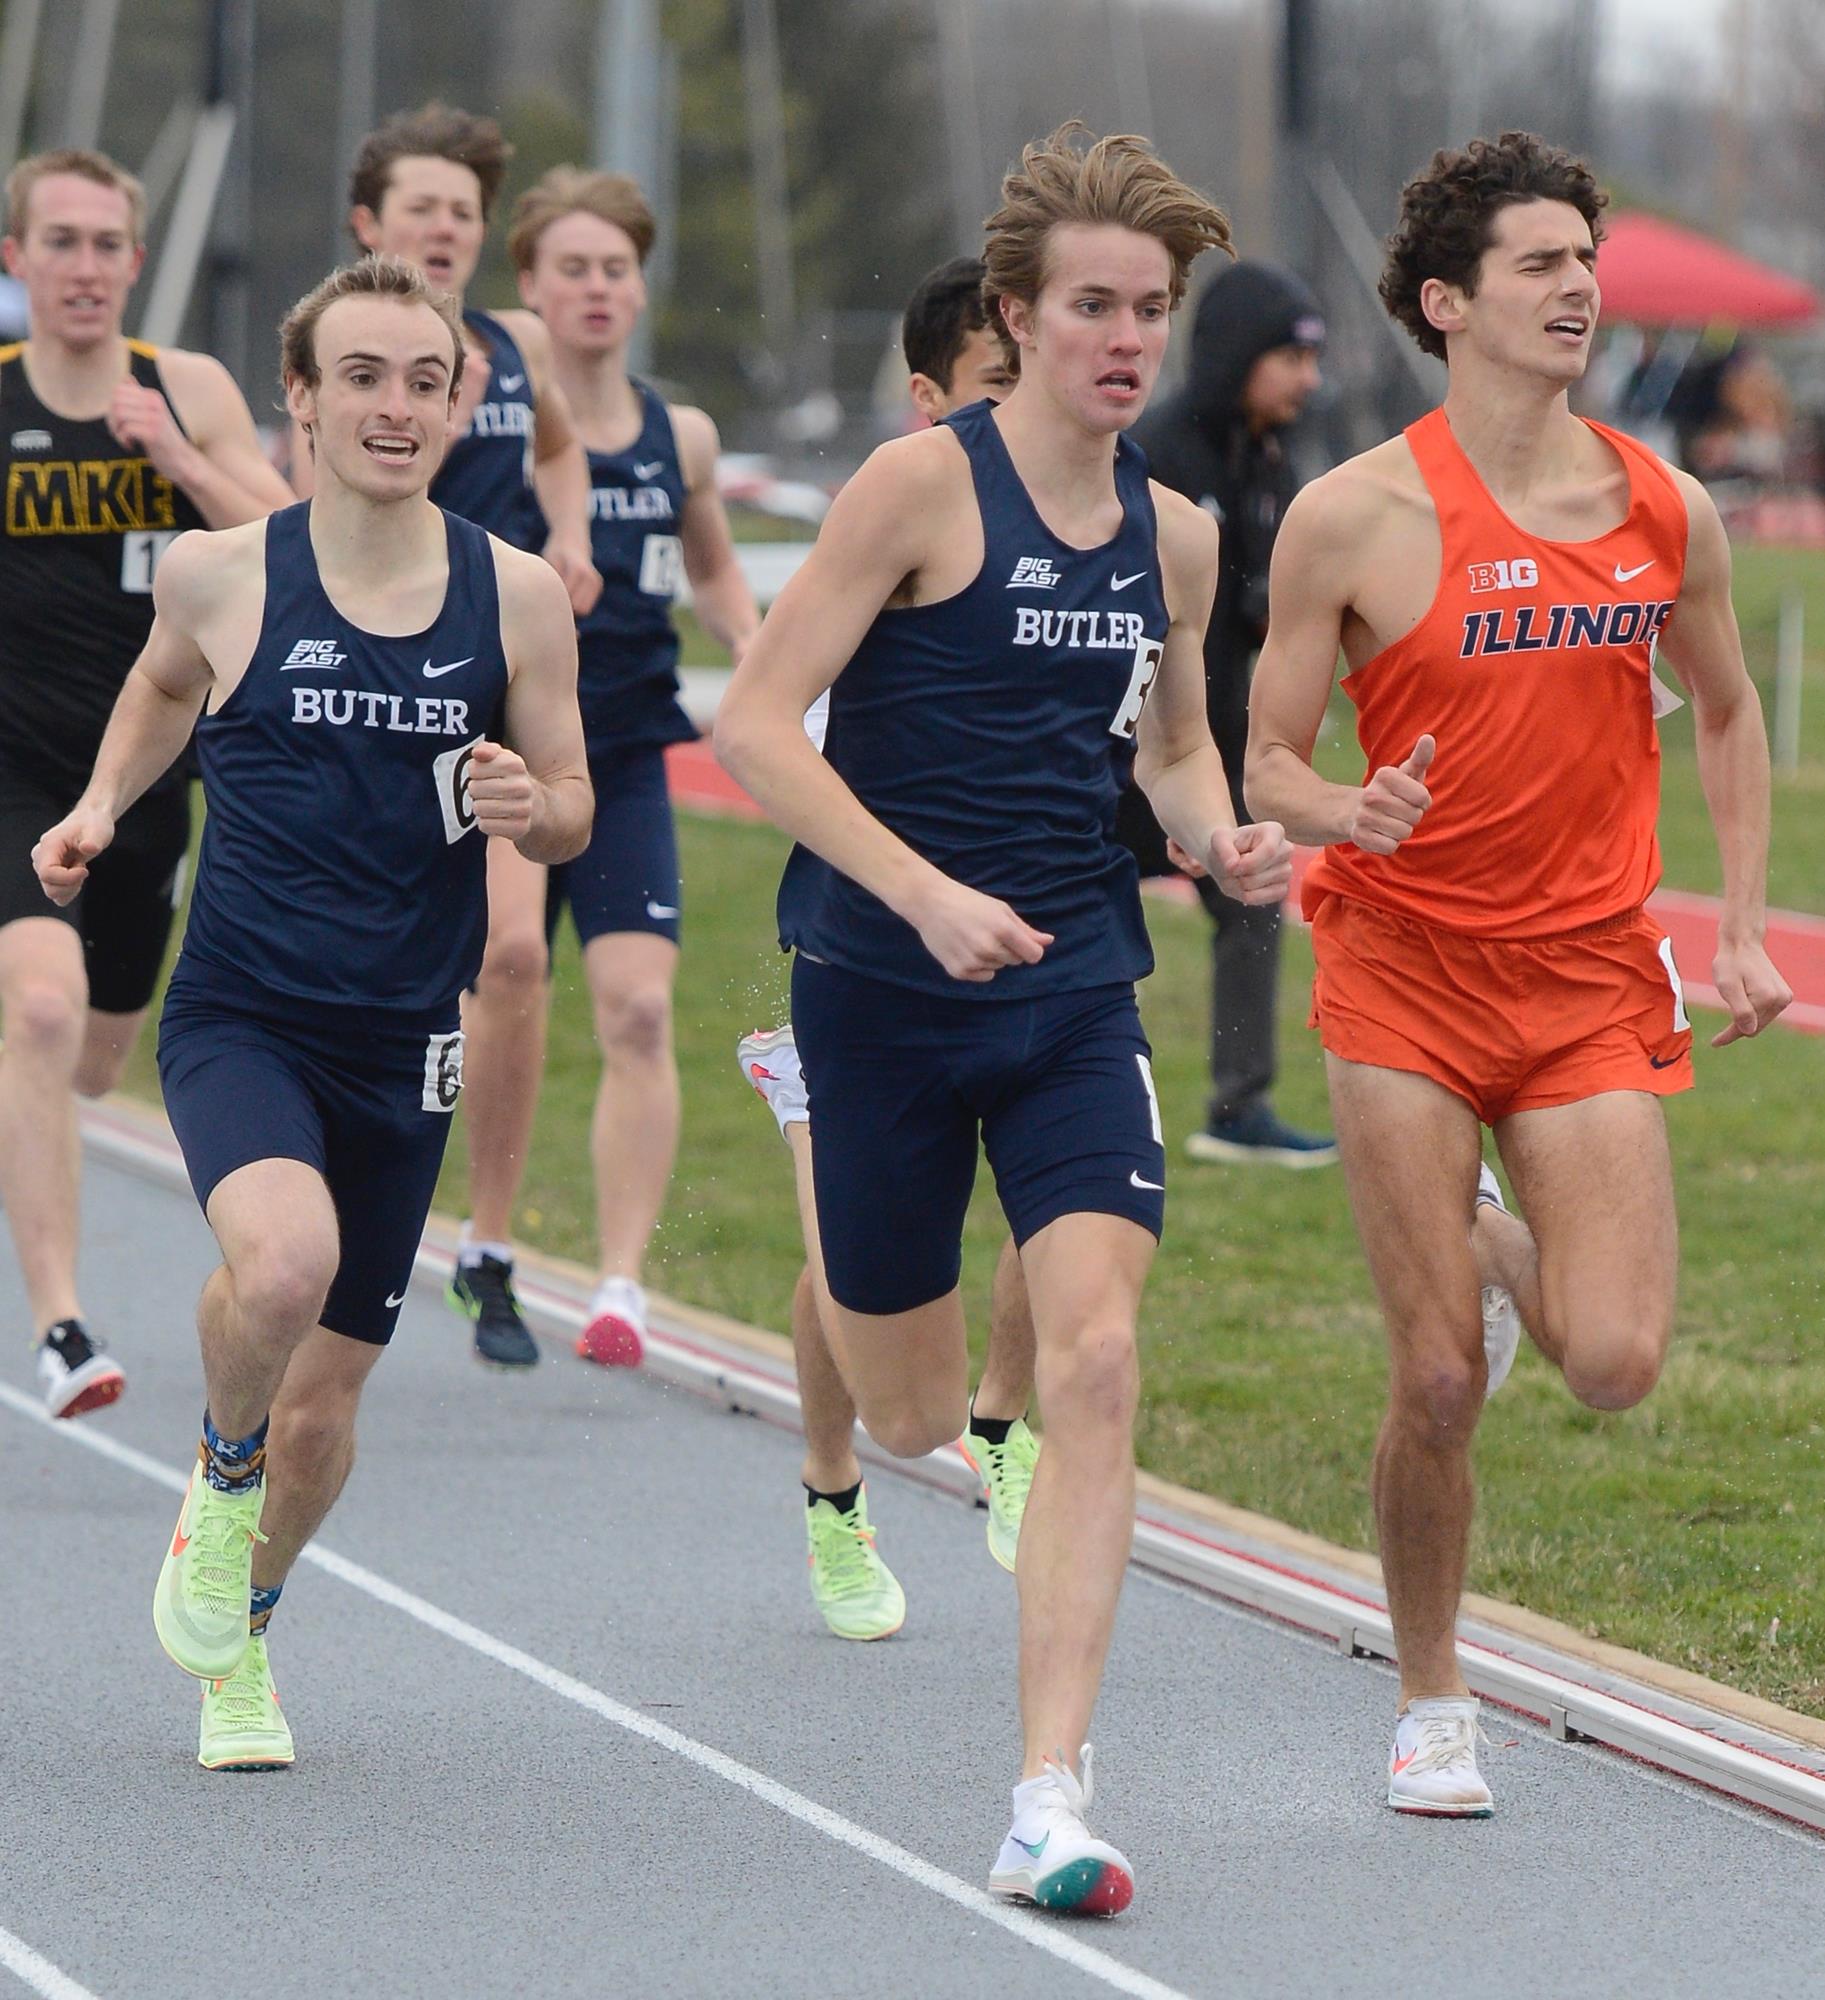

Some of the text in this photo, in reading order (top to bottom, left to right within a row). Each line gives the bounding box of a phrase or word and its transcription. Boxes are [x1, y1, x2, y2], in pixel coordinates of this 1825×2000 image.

[6, 456, 176, 536] MKE
[1017, 556, 1053, 572] BIG
[1010, 570, 1062, 587] EAST
[1012, 607, 1145, 650] BUTLER
[294, 639, 338, 654] BIG
[284, 652, 348, 668] EAST
[291, 687, 469, 735] BUTLER
